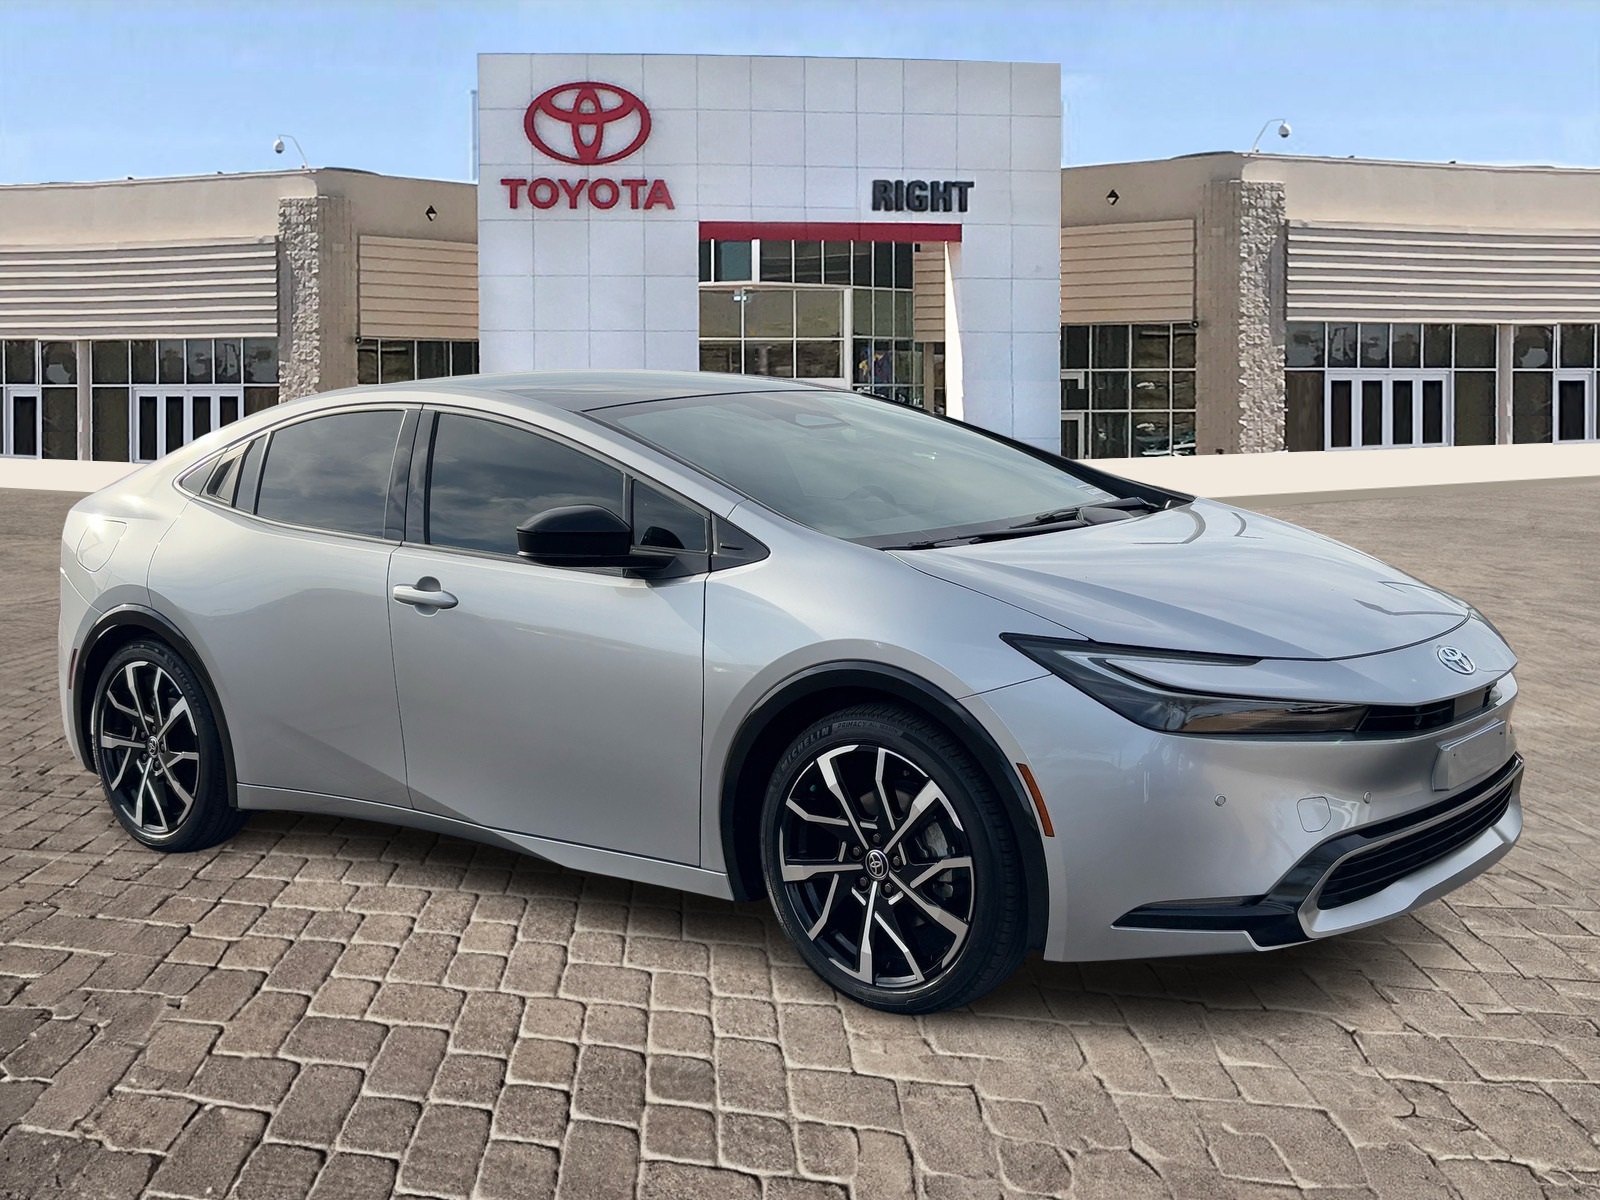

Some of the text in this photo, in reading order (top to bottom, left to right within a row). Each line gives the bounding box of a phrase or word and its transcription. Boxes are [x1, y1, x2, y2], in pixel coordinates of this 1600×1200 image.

[501, 179, 674, 209] TOYOTA
[872, 180, 974, 212] RIGHT
[837, 721, 867, 729] PRIMACY
[781, 727, 829, 770] MICHELIN
